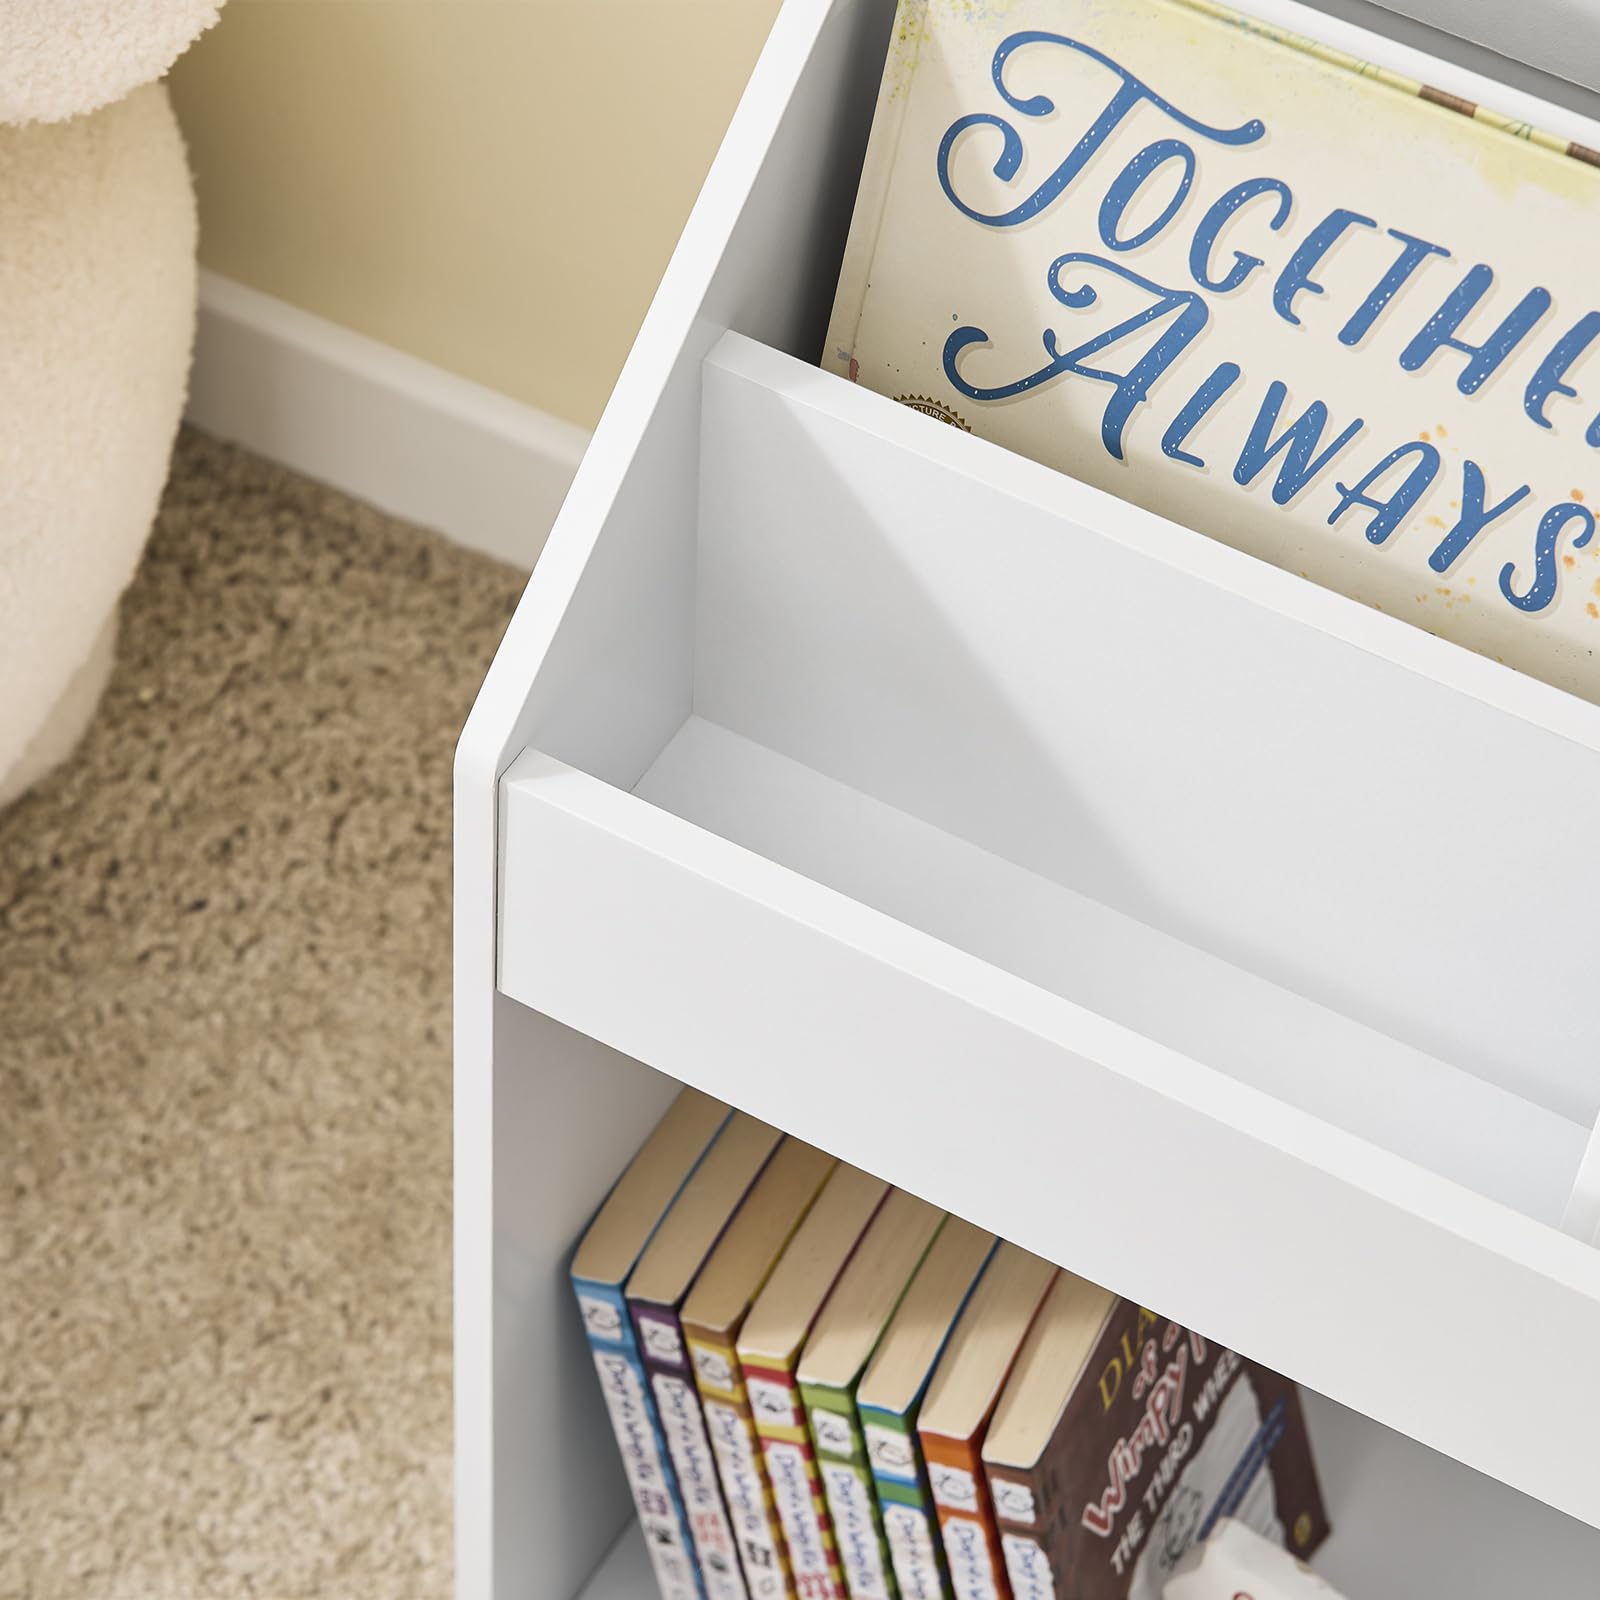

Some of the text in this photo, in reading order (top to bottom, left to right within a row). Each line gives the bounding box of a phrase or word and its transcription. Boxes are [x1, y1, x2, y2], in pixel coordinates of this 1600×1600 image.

[937, 30, 1600, 448] TOGETHE
[909, 404, 946, 422] CTURE
[943, 252, 1596, 612] ALWAYS
[1082, 1342, 1188, 1537] Wimpy
[1098, 1307, 1158, 1414] DIA
[1110, 1511, 1144, 1575] THE
[1143, 1422, 1193, 1512] THIRD
